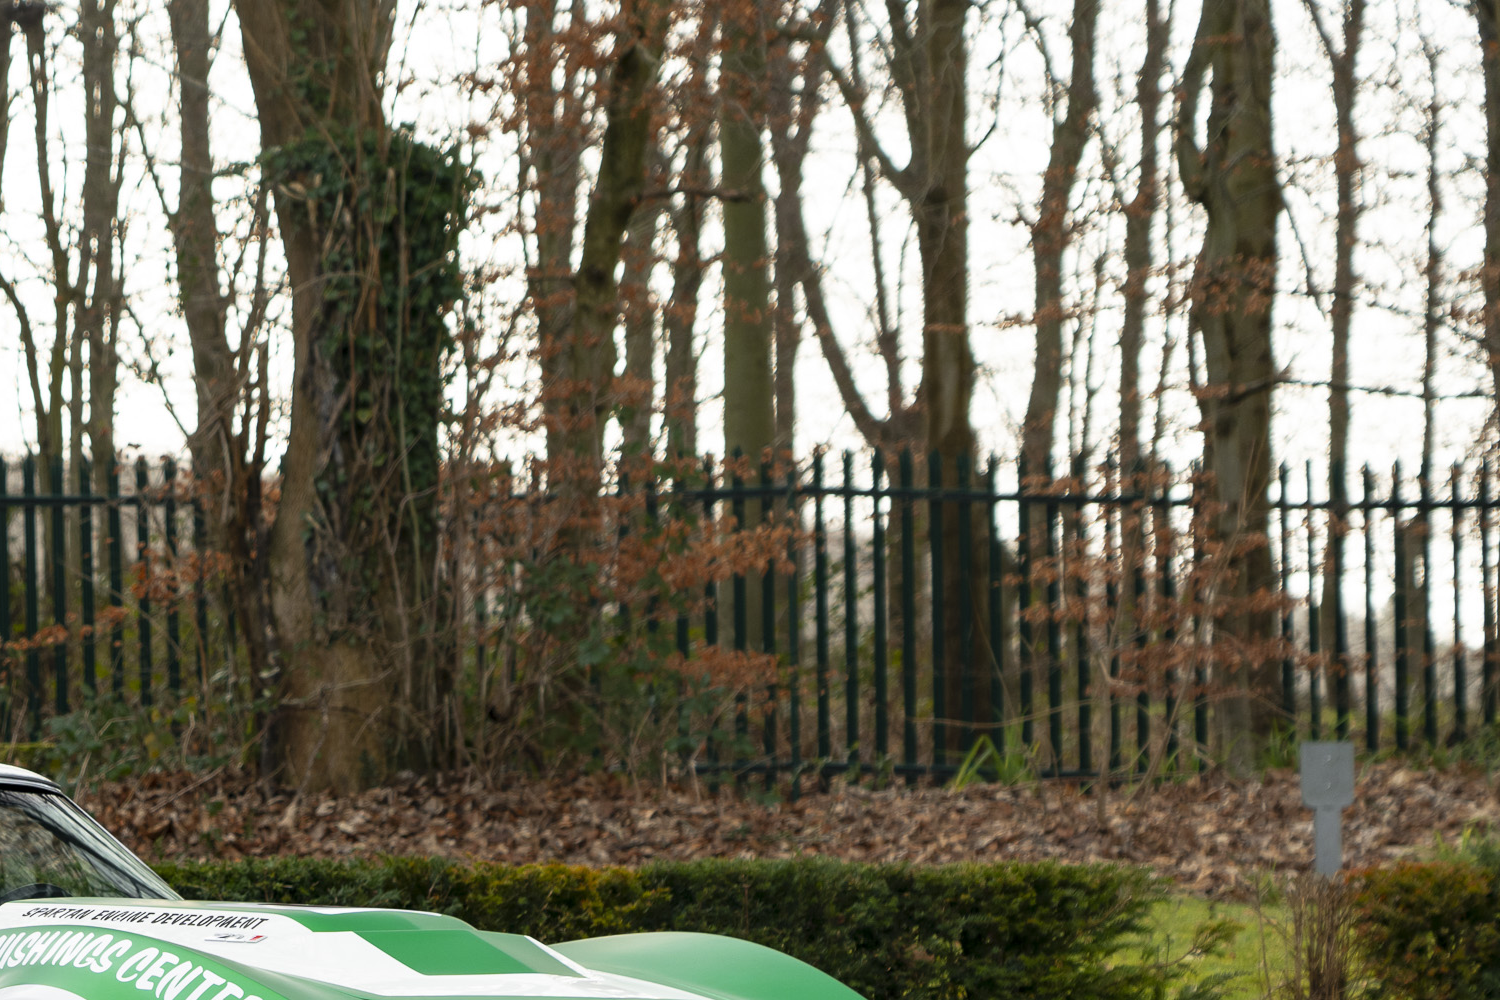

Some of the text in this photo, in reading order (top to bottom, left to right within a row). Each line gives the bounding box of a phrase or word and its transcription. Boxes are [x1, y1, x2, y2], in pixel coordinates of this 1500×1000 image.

[22, 907, 270, 930] SPARTAN ENGINE DEVELOPMENT
